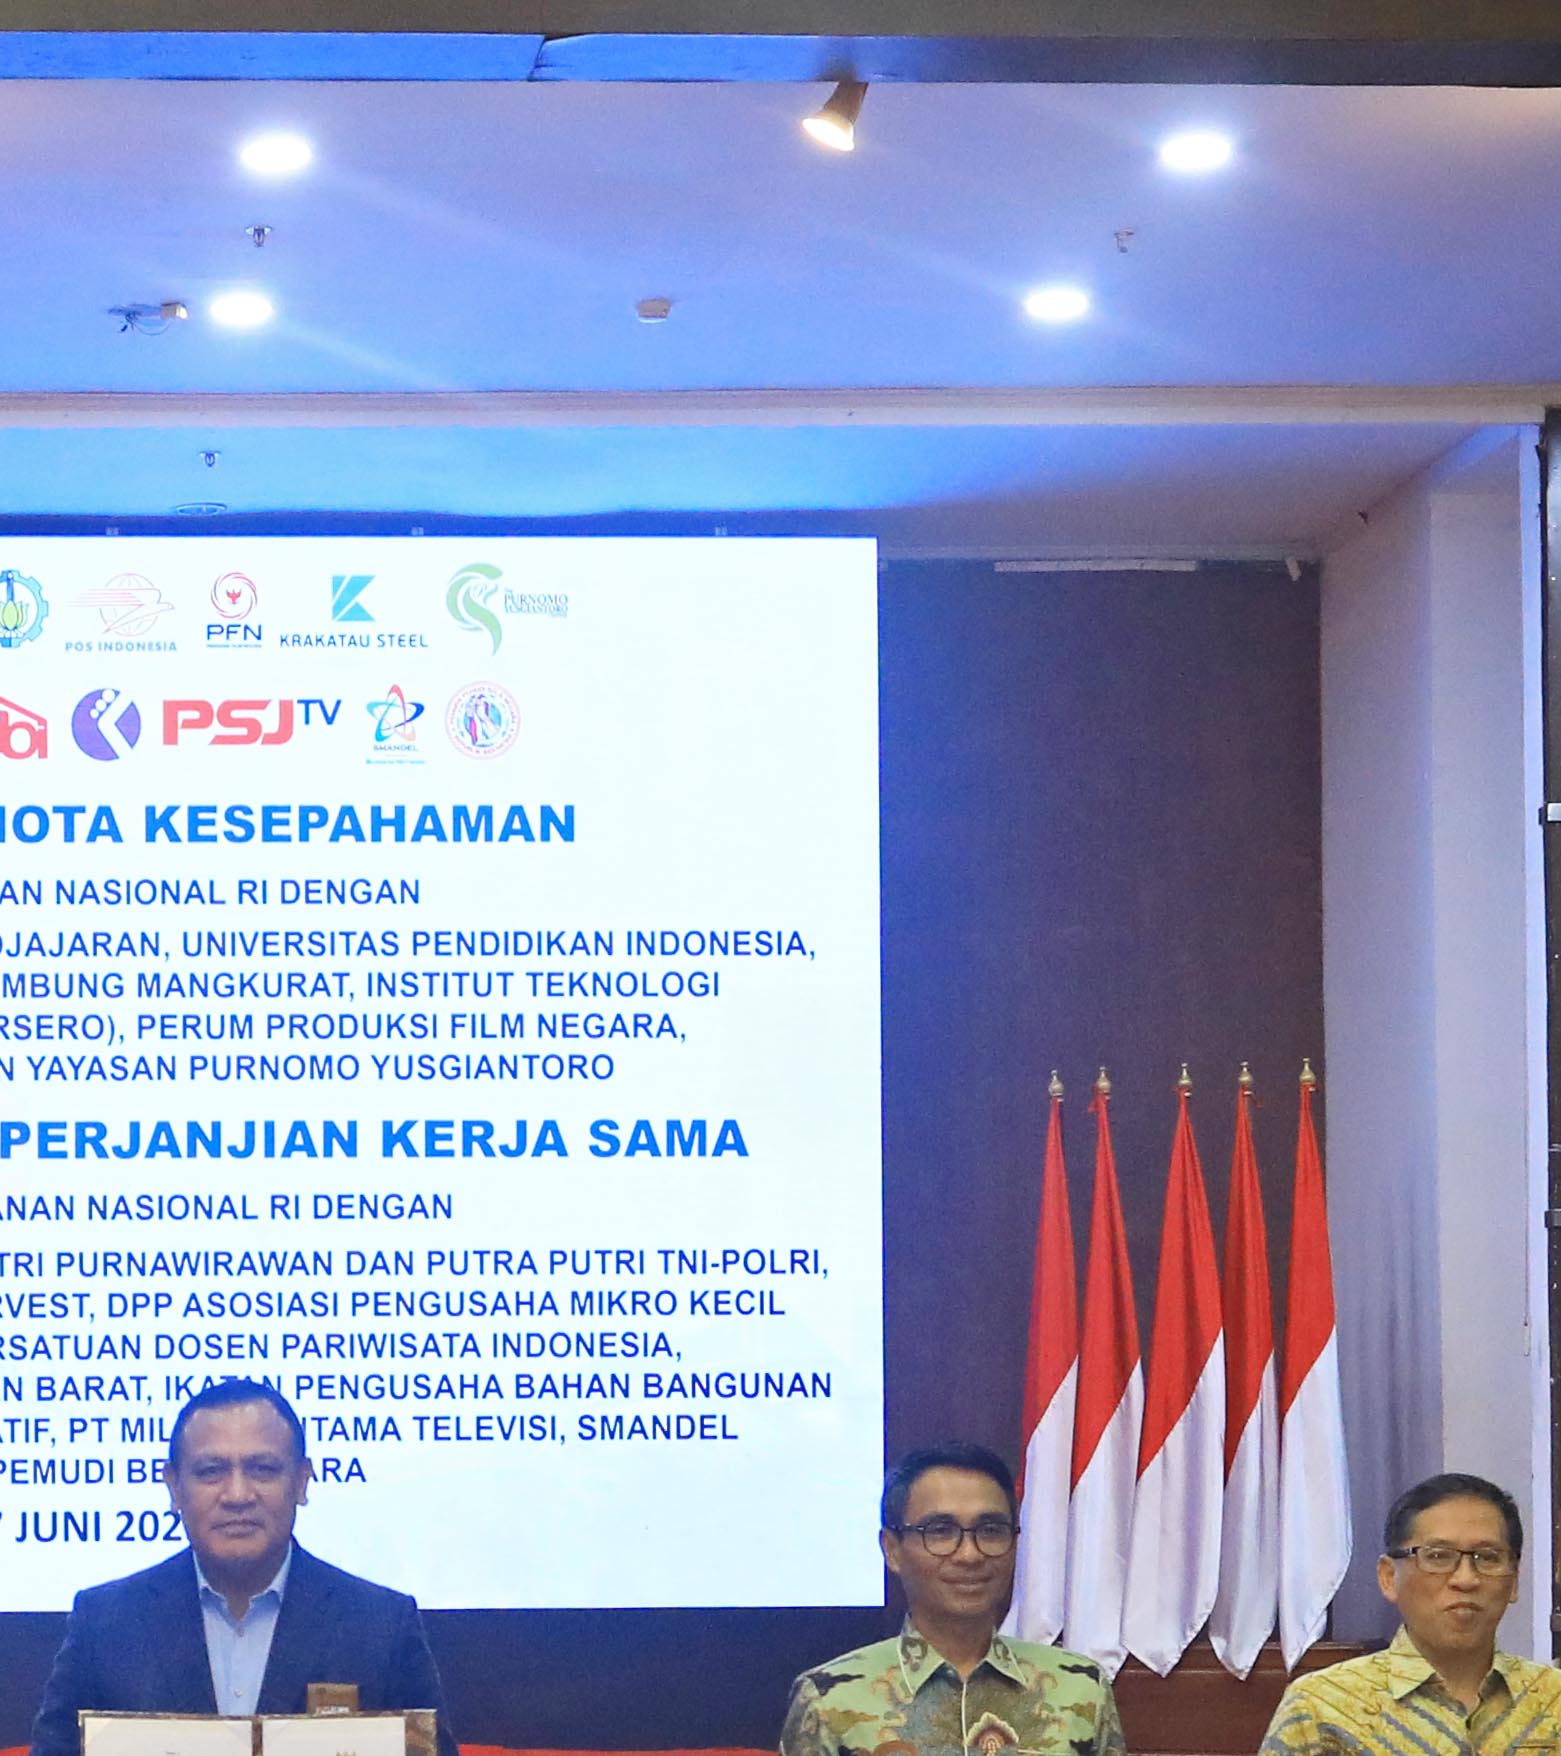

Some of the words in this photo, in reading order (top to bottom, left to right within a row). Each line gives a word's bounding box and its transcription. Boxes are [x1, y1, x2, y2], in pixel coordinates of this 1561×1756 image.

[65, 641, 92, 652] POS
[98, 641, 177, 652] INDONESIA
[207, 624, 262, 640] PFN
[279, 634, 370, 648] KRAKATAU
[377, 634, 428, 648] STEEL
[162, 699, 294, 746] PSJ
[297, 699, 342, 725] TV
[145, 805, 574, 843] KESEPAHAMAN
[56, 879, 226, 905] NASIONAL
[238, 880, 267, 904] RI
[281, 879, 419, 904] DENGAN
[183, 931, 399, 957] UNIVERSITAS
[413, 931, 613, 956] PENDIDIKAN
[627, 930, 814, 960] INDONESIA,
[138, 972, 354, 1001] MANGKURAT,
[368, 972, 514, 997] INSTITUT
[526, 971, 719, 997] TEKNOLOGI
[138, 1014, 253, 1039] PERUM
[267, 1013, 437, 1039] PRODUKSI
[451, 1013, 524, 1039] FILM
[538, 1013, 685, 1042] NEGARA,
[27, 1055, 176, 1081] YAYASAN
[190, 1054, 359, 1081] PURNOMO
[371, 1054, 614, 1080] YUSGIANTORO
[0, 1120, 357, 1159] PERJANJIAN
[382, 1120, 568, 1158] KERJA
[589, 1119, 749, 1158] SAMA
[88, 1194, 258, 1220] NASIONAL
[271, 1195, 299, 1220] RI
[313, 1194, 451, 1219] DENGAN
[57, 1251, 332, 1277] PURNAWIRAWAN
[347, 1250, 413, 1276] DAN
[428, 1250, 538, 1275] PUTRA
[550, 1250, 644, 1275] PUTRI
[657, 1249, 828, 1279] TNI-POLRI,
[108, 1293, 172, 1318] DPP
[182, 1291, 338, 1318] ASOSIASI
[352, 1290, 559, 1317] PENGUSAHA
[571, 1290, 677, 1316] MIKRO
[690, 1290, 785, 1315] KECIL
[155, 1334, 268, 1360] DOSEN
[283, 1332, 481, 1359] PARIWISATA
[493, 1332, 681, 1362] INDONESIA,
[37, 1376, 152, 1405] BARAT,
[296, 1374, 504, 1400] PENGUSAHA
[515, 1373, 629, 1399] BAHAN
[644, 1372, 831, 1398] BANGUNAN
[69, 1417, 109, 1443] PT
[302, 1416, 402, 1442] TAMA
[412, 1415, 565, 1445] TELEVISI,
[578, 1414, 738, 1440] SMANDEL
[16, 1511, 100, 1543] JUNI
